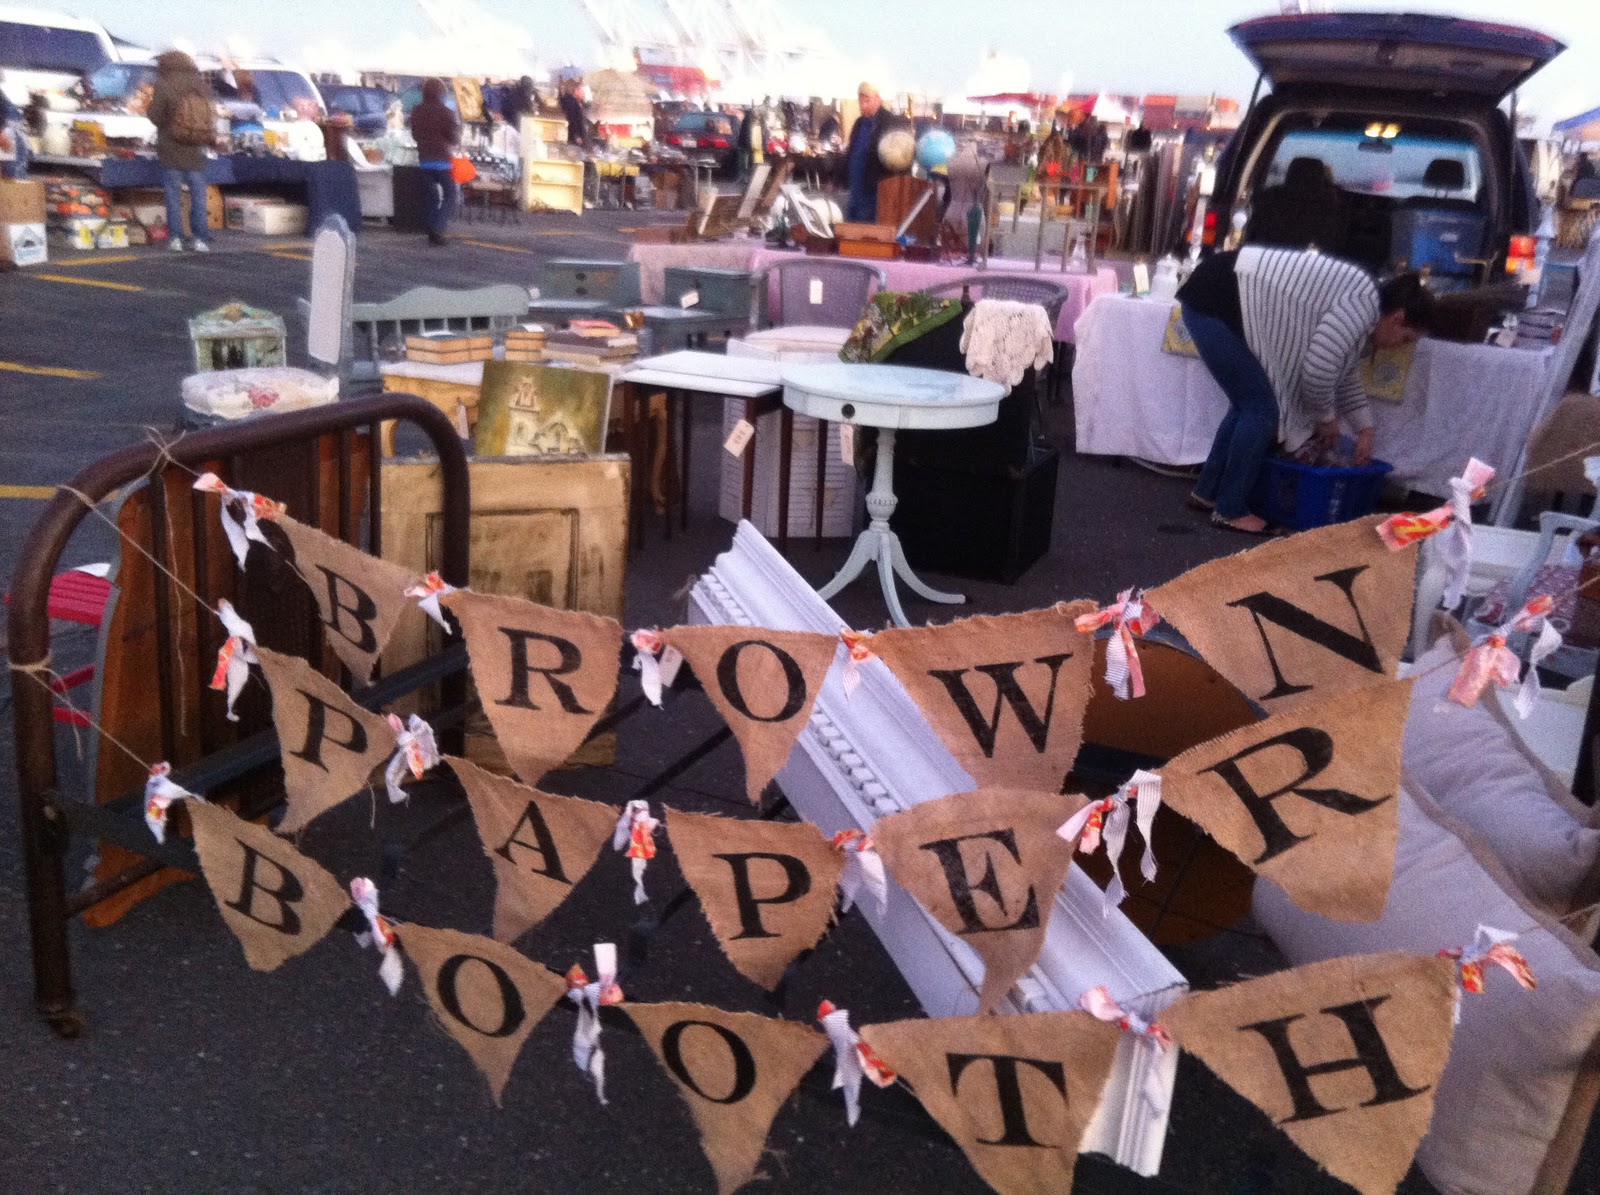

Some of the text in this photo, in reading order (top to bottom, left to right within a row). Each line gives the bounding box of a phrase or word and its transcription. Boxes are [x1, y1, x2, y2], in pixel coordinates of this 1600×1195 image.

[316, 564, 1385, 757] BROWN
[291, 690, 1392, 940] PAPER
[226, 838, 1431, 1148] BOOTH
